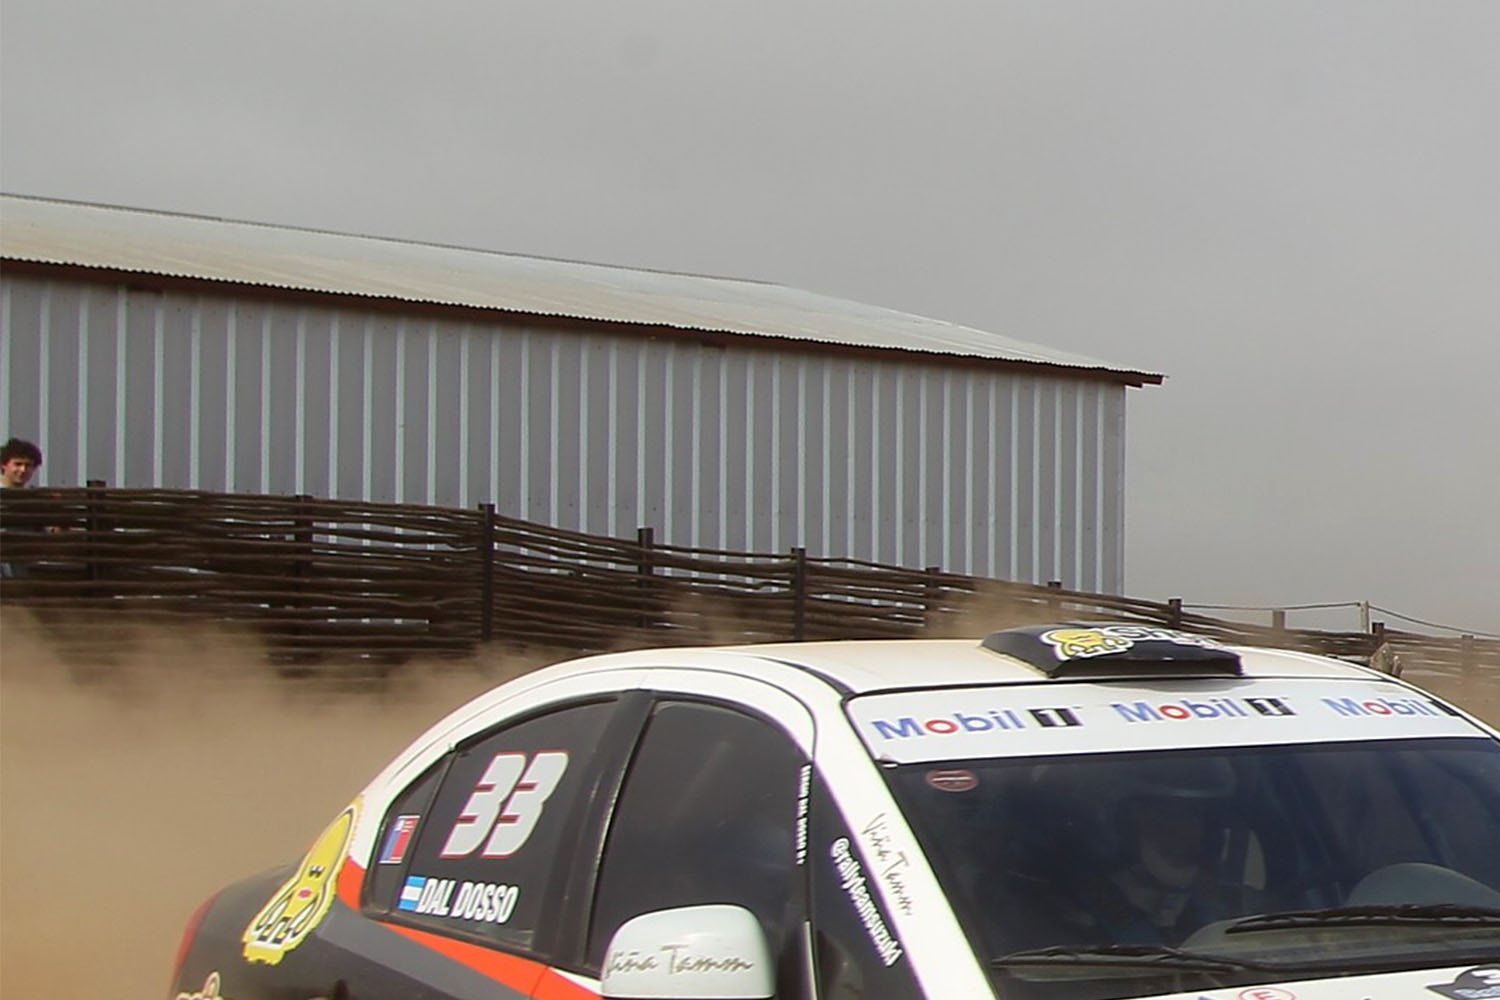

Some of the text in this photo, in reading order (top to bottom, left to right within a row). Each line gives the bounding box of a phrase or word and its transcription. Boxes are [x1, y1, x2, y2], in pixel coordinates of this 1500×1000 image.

[1110, 697, 1250, 723] Mobil
[1321, 697, 1439, 717] Mobil
[871, 710, 1026, 740] Mobil
[441, 750, 570, 858] 33
[415, 877, 520, 924] DAL DOSSO
